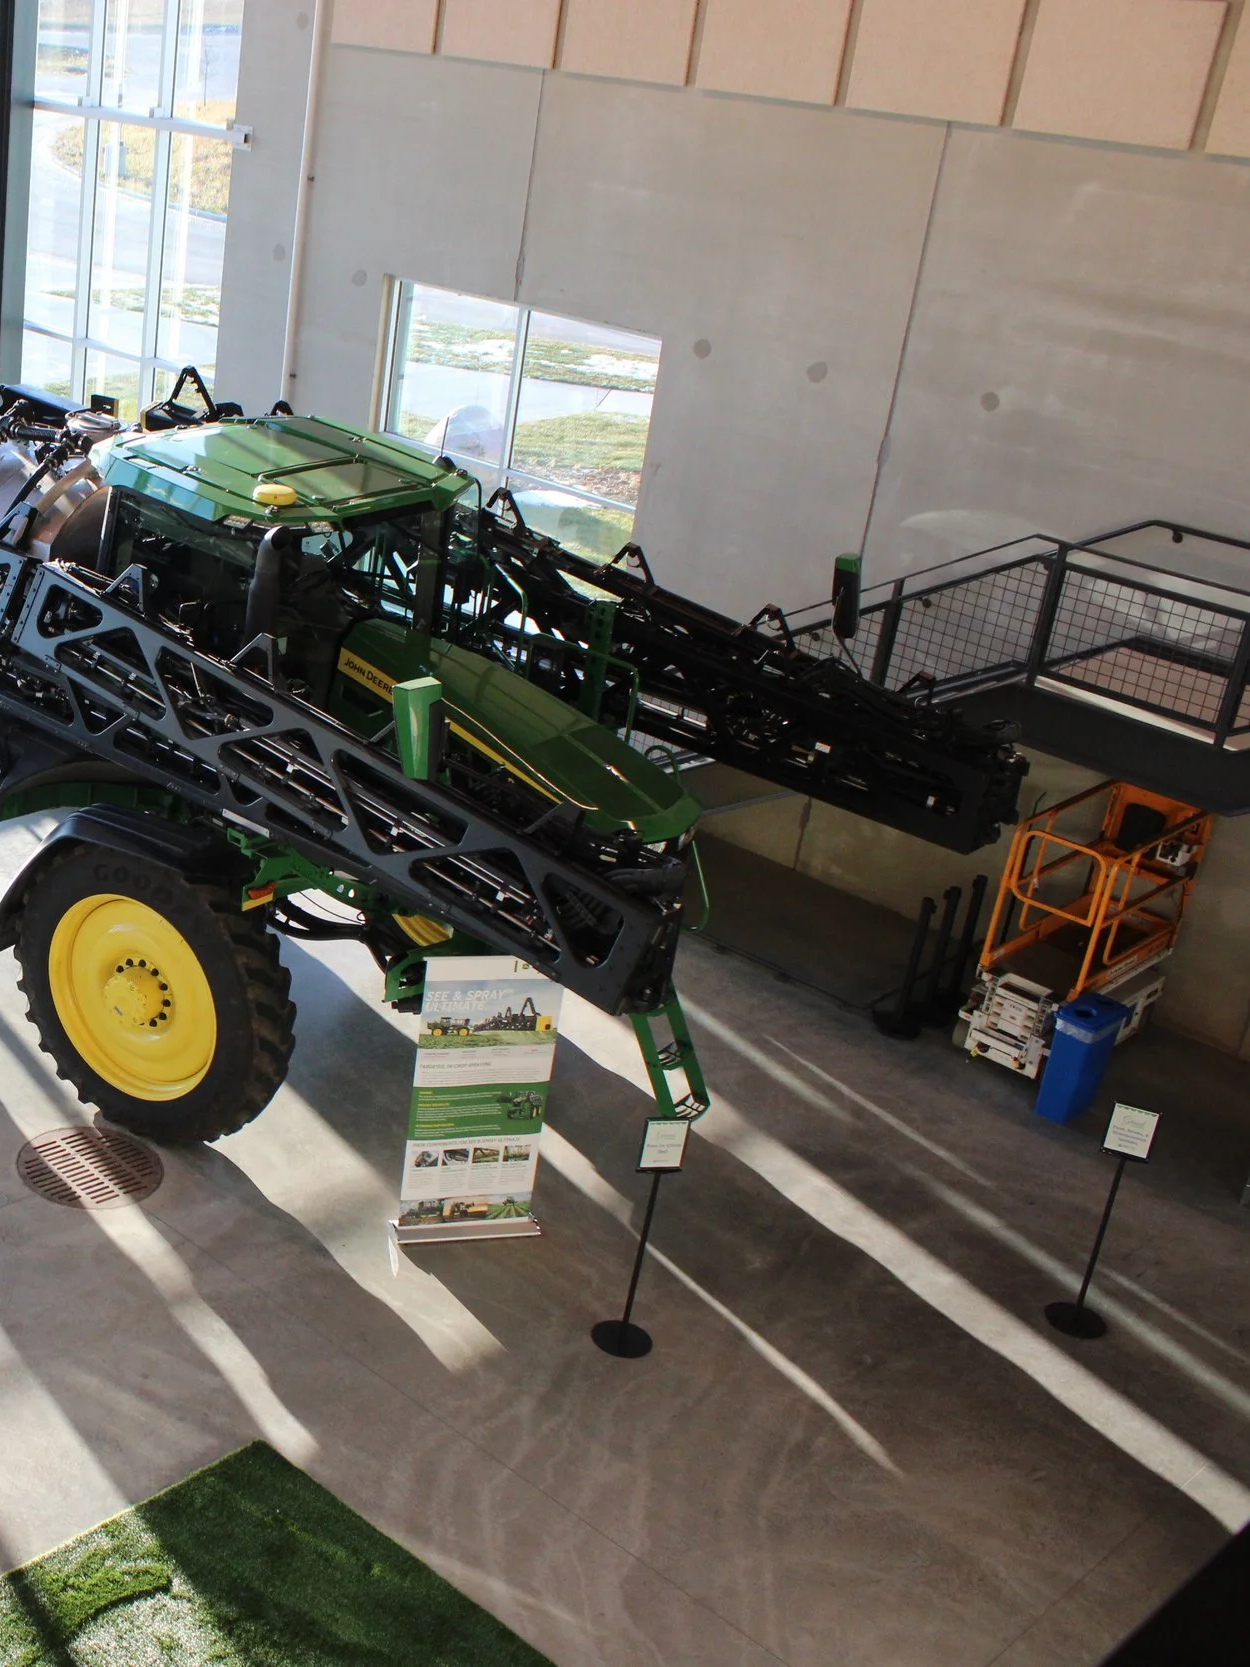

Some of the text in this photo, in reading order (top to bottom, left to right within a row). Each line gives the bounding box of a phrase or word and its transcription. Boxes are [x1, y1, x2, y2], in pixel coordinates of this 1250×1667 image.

[344, 658, 393, 695] JOHN DEERE
[426, 991, 448, 1002] SEE
[453, 991, 462, 1001] &
[425, 1001, 486, 1012] ULTIMATE
